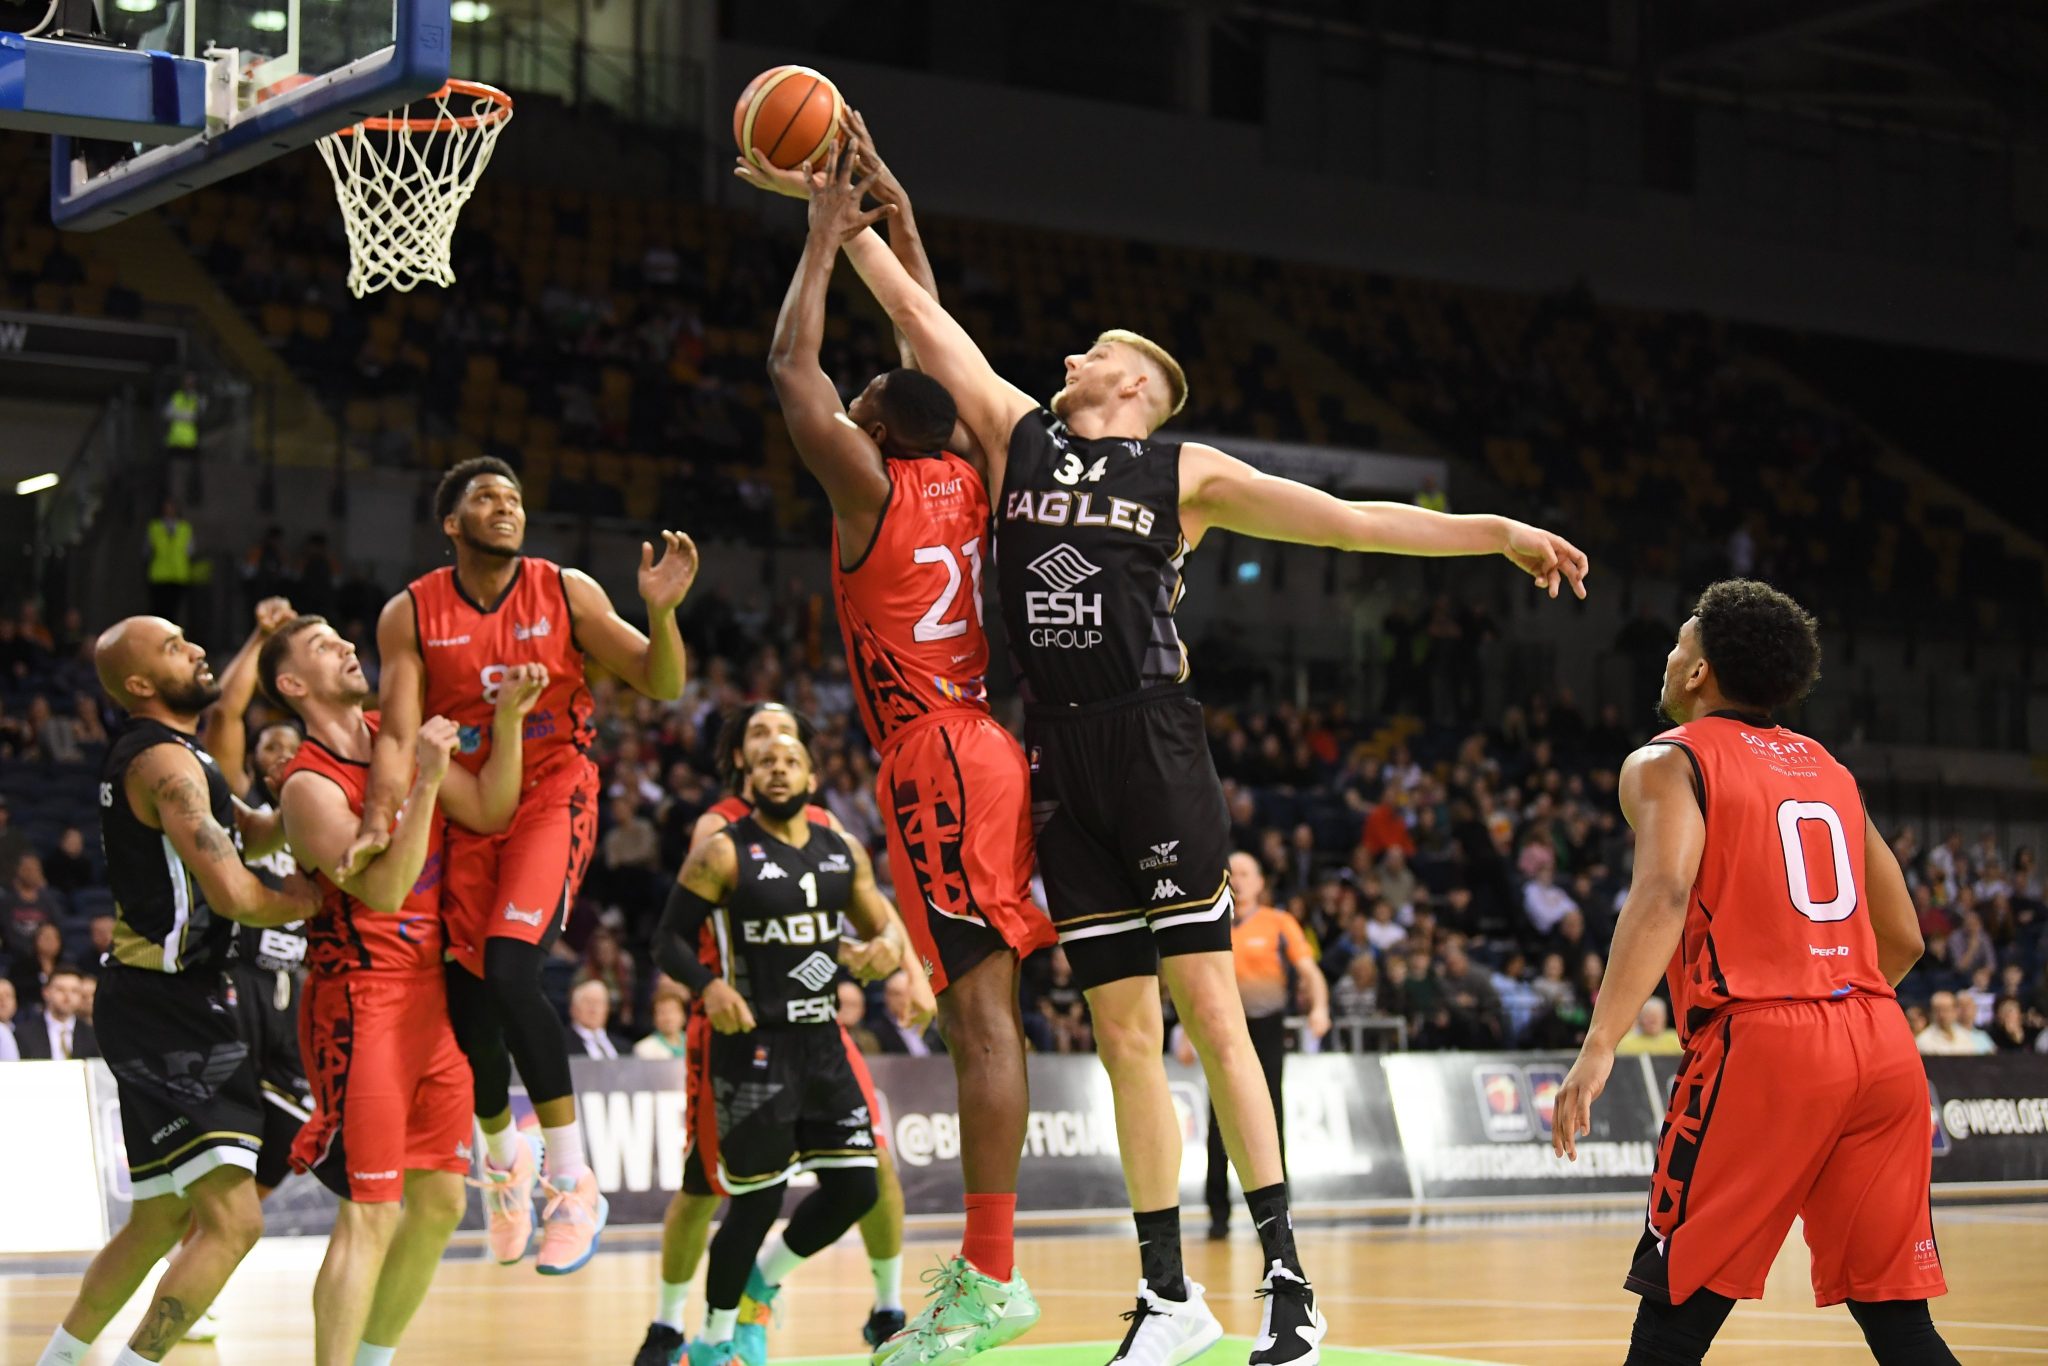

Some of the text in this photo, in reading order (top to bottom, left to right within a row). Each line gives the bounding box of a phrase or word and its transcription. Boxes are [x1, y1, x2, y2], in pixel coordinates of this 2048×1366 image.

[1053, 453, 1109, 486] 34
[1006, 490, 1155, 537] EAGLES
[913, 537, 983, 642] 21
[1026, 591, 1102, 626] ESH
[1030, 629, 1103, 649] GROUP
[1777, 799, 1857, 922] 0
[799, 872, 818, 908] 1
[743, 911, 845, 944] EAGL
